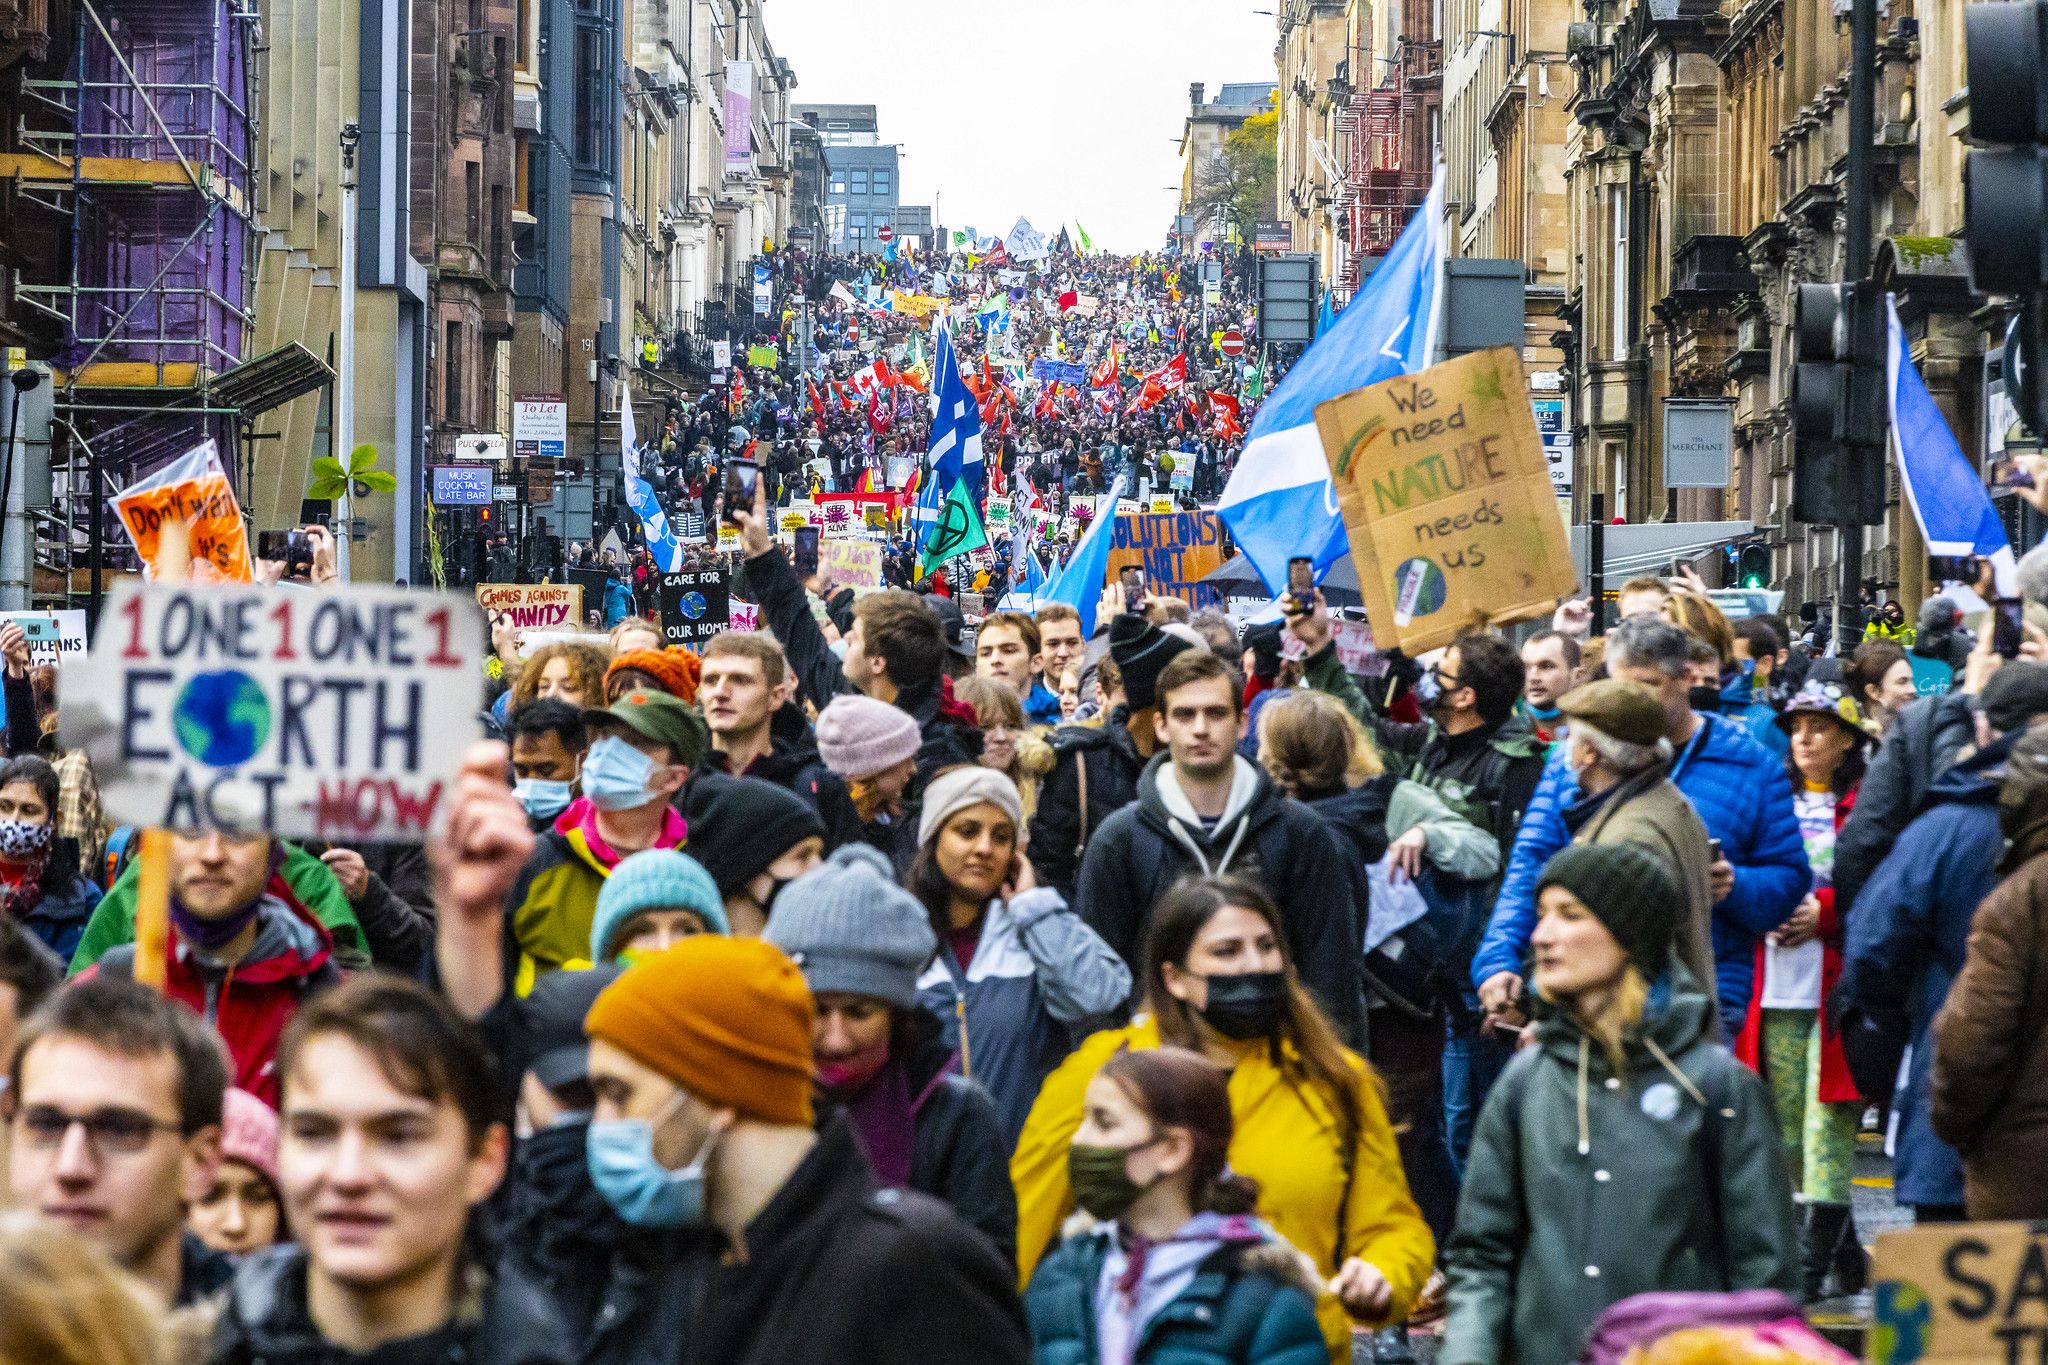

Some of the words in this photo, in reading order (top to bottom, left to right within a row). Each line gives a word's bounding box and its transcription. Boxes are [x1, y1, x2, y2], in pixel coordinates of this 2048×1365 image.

[582, 338, 594, 351] 191
[522, 403, 537, 412] To
[539, 404, 558, 413] Let
[1387, 382, 1438, 414] We
[1390, 404, 1466, 448] need
[457, 440, 504, 448] PULCELLA
[448, 472, 476, 480] MUSIC
[1371, 434, 1505, 514] NATURE
[438, 482, 487, 490] COCKTAILS
[439, 492, 461, 500] LATE
[466, 492, 486, 500] BAR
[128, 494, 186, 536] Don't
[1414, 500, 1504, 543] needs
[828, 524, 847, 532] ALIVE
[1110, 510, 1216, 550] OLUTIONS
[1143, 547, 1186, 584] NOT
[1442, 544, 1486, 569] us
[664, 573, 694, 586] CARE
[700, 572, 720, 584] FOR
[480, 589, 521, 607] CRIMES
[526, 589, 568, 604] AGAINST
[502, 604, 570, 627] MANITY
[667, 625, 692, 638] OUR
[698, 622, 728, 636] HOME
[1919, 677, 1950, 695] Caf
[124, 668, 425, 773] ERTH
[162, 768, 288, 832] ACT
